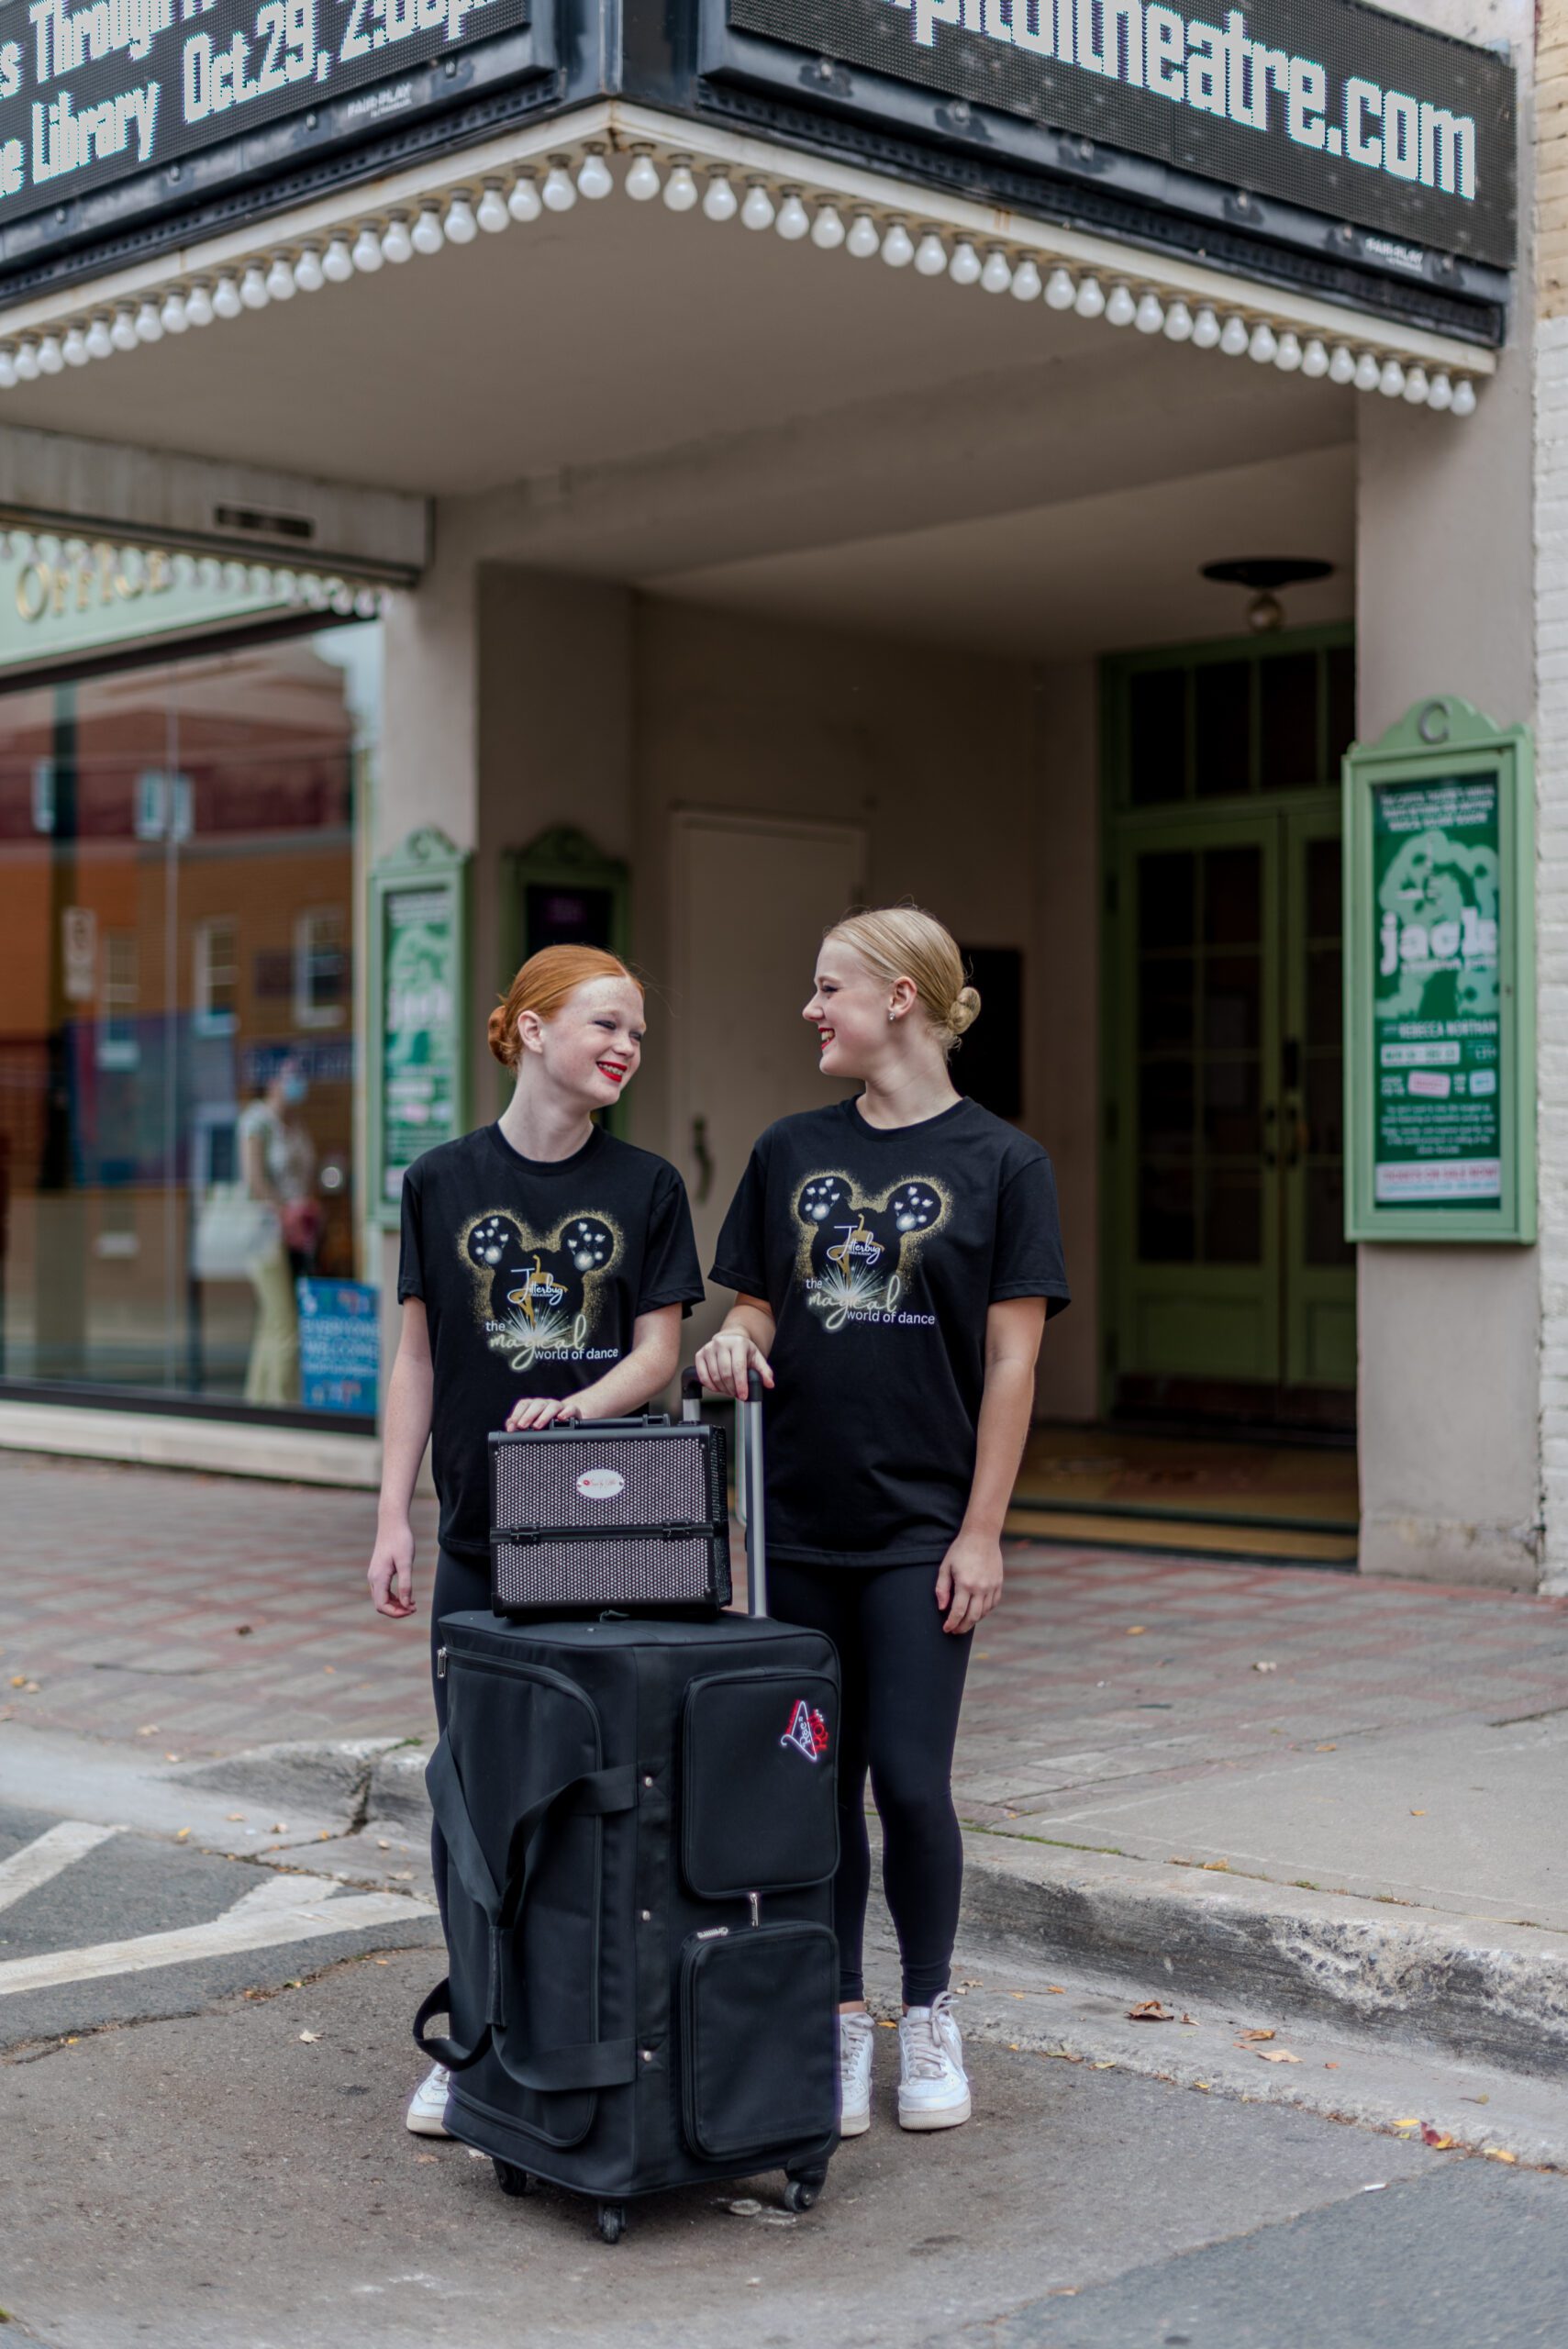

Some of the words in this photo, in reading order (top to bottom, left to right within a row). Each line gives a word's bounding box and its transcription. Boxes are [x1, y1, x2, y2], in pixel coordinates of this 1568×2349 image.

[31, 81, 161, 184] Library
[1380, 906, 1497, 976] jack
[806, 1278, 823, 1289] the
[808, 1275, 900, 1330] magical
[847, 1309, 880, 1322] world
[883, 1311, 895, 1323] of
[898, 1312, 936, 1325] dance
[485, 1319, 506, 1331] the
[490, 1314, 587, 1370] magical
[534, 1348, 569, 1360] world
[571, 1348, 584, 1360] of
[586, 1347, 618, 1360] dance
